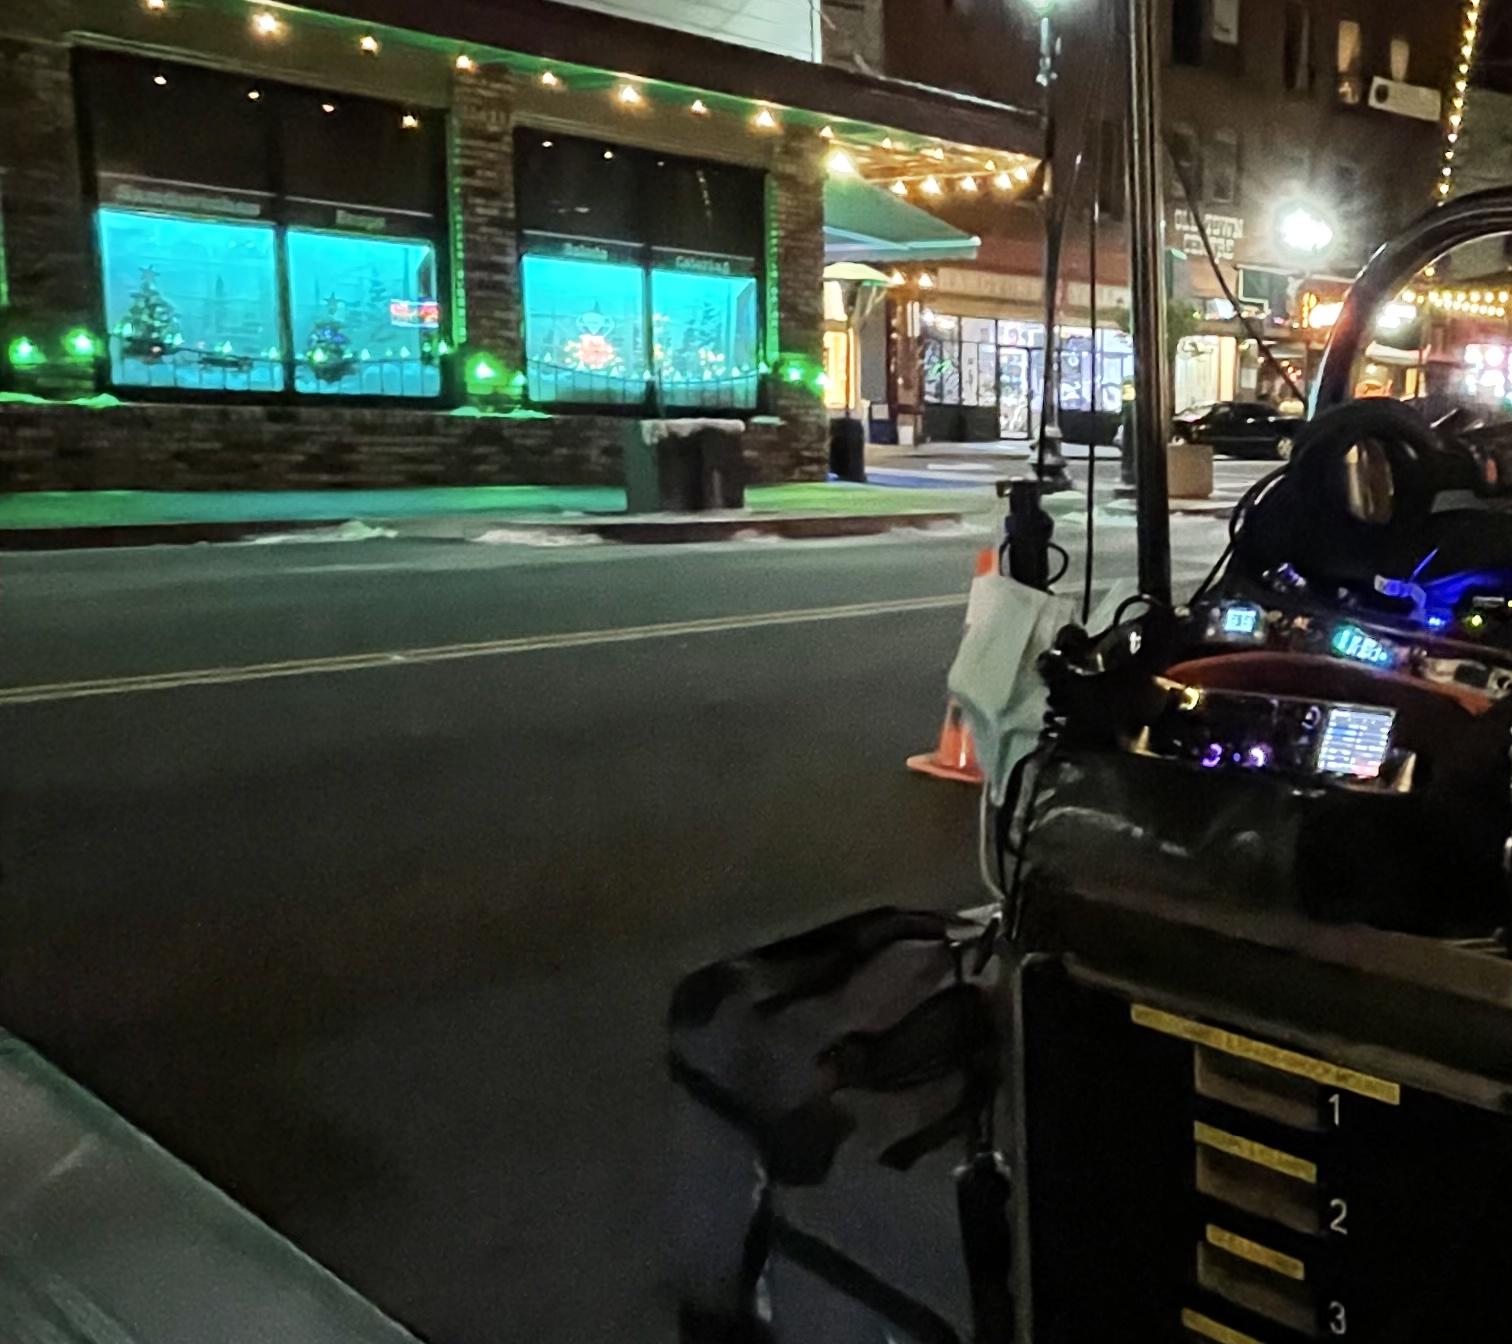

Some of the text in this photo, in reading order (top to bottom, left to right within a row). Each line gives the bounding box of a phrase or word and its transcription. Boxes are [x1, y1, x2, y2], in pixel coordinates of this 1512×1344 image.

[1328, 1093, 1340, 1127] 1
[1329, 1197, 1348, 1235] 2
[1329, 1300, 1347, 1336] 3
